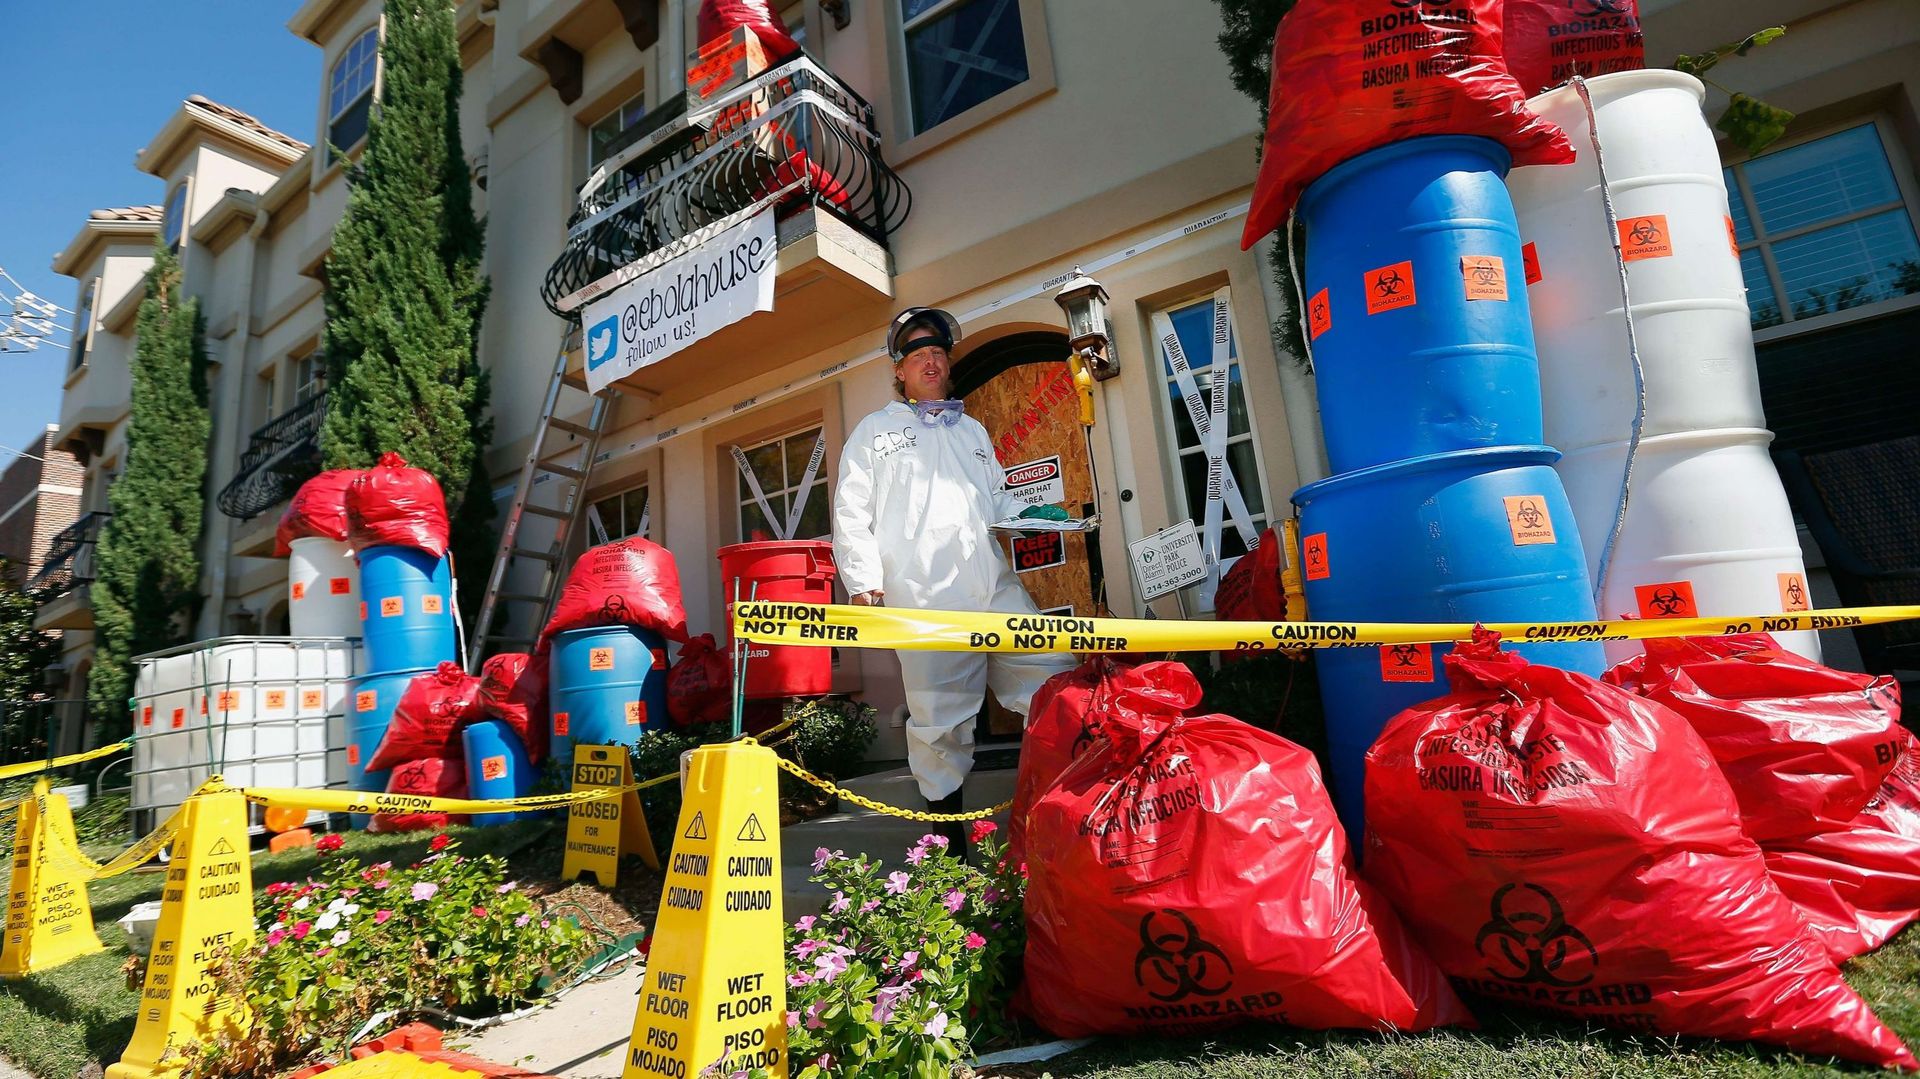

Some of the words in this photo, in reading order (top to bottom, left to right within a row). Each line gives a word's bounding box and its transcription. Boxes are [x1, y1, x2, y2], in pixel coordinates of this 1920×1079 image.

[1549, 16, 1640, 37] BIOHAZA
[1364, 31, 1437, 60] INFECTIOUS
[1551, 33, 1619, 57] INFECTIOUS
[757, 64, 793, 87] QUARANTINE
[1362, 62, 1409, 89] BASURA
[650, 120, 679, 144] QUARANTINE
[1627, 245, 1668, 256] BIOHAZARD
[622, 236, 765, 343] @ebolahouse
[1042, 271, 1076, 290] QUARANTI
[1372, 294, 1411, 309] BIOHAZARD
[1215, 300, 1228, 345] QUARANTINE
[626, 333, 666, 367] follow
[673, 313, 696, 341] us!
[1162, 333, 1188, 374] QUARANTINE
[1213, 369, 1227, 414] QUARANTINE
[1186, 393, 1211, 435] QUARANTINE
[873, 426, 917, 452] CDC
[808, 438, 825, 473] QUARANTINE
[879, 440, 917, 460] TRAINEE
[733, 447, 751, 476] QUARANTINE
[1011, 466, 1050, 483] DANGER
[1208, 455, 1223, 502] QUARANTINE
[1013, 487, 1035, 498] HARD
[1036, 483, 1052, 494] HAT
[1024, 495, 1044, 505] AREA
[1015, 533, 1059, 553] KEEP
[1161, 533, 1194, 554] UNIVERSITY
[1517, 530, 1551, 539] BIOHAZARD
[1022, 549, 1055, 567] OUT
[1164, 551, 1180, 564] PARK
[1166, 558, 1188, 574] POLICE
[1142, 562, 1162, 574] Direct
[1145, 569, 1163, 580] Alarm
[1147, 567, 1202, 594] 214-363-3000
[737, 604, 826, 622] CAUTION
[743, 620, 787, 635] NOT
[800, 623, 858, 641] ENTER
[1006, 617, 1095, 634] CAUTION
[1271, 625, 1357, 640] CAUTION
[1525, 624, 1608, 638] CAUTION
[1724, 622, 1752, 634] DO
[1762, 617, 1799, 632] NOT
[1811, 615, 1862, 629] ENTER
[970, 632, 1001, 648] DO
[1014, 634, 1057, 649] NOT
[1070, 636, 1128, 651] ENTER
[578, 766, 617, 784] STOP
[1419, 766, 1483, 791] BASURA
[347, 804, 369, 812] DO
[375, 796, 432, 809] CAUTION
[571, 801, 619, 820] CLOSED
[584, 826, 599, 837] FOR
[567, 841, 616, 857] MAINTENANCE
[200, 861, 241, 879] CAUTION
[673, 853, 709, 876] CAUTION
[728, 856, 772, 877] CAUTION
[14, 892, 25, 900] WET
[41, 889, 75, 905] FLOOR
[45, 882, 69, 894] WET
[199, 882, 240, 900] CUIDADO
[667, 886, 703, 911] CUIDADO
[726, 890, 771, 912] CUIDADO
[39, 908, 82, 926] MOJADO
[47, 902, 72, 915] PISO
[159, 941, 174, 951] WET
[202, 931, 234, 947] WET
[152, 955, 175, 966] FLOOR
[193, 945, 232, 964] FLOO
[152, 974, 169, 985] PISO
[658, 971, 686, 993] WET
[727, 973, 764, 996] WET
[145, 988, 171, 1000] MOJADO
[186, 981, 218, 999] MOJ
[1452, 976, 1652, 1006] BIOHAZARD
[646, 993, 689, 1020] FLOOR
[717, 995, 772, 1022] FLOOR
[1122, 991, 1283, 1020] BIOHAZARD
[646, 1027, 678, 1052] PISO
[724, 1028, 764, 1052] PISO
[631, 1048, 686, 1079] MOJADO
[716, 1048, 780, 1077] OJADO
